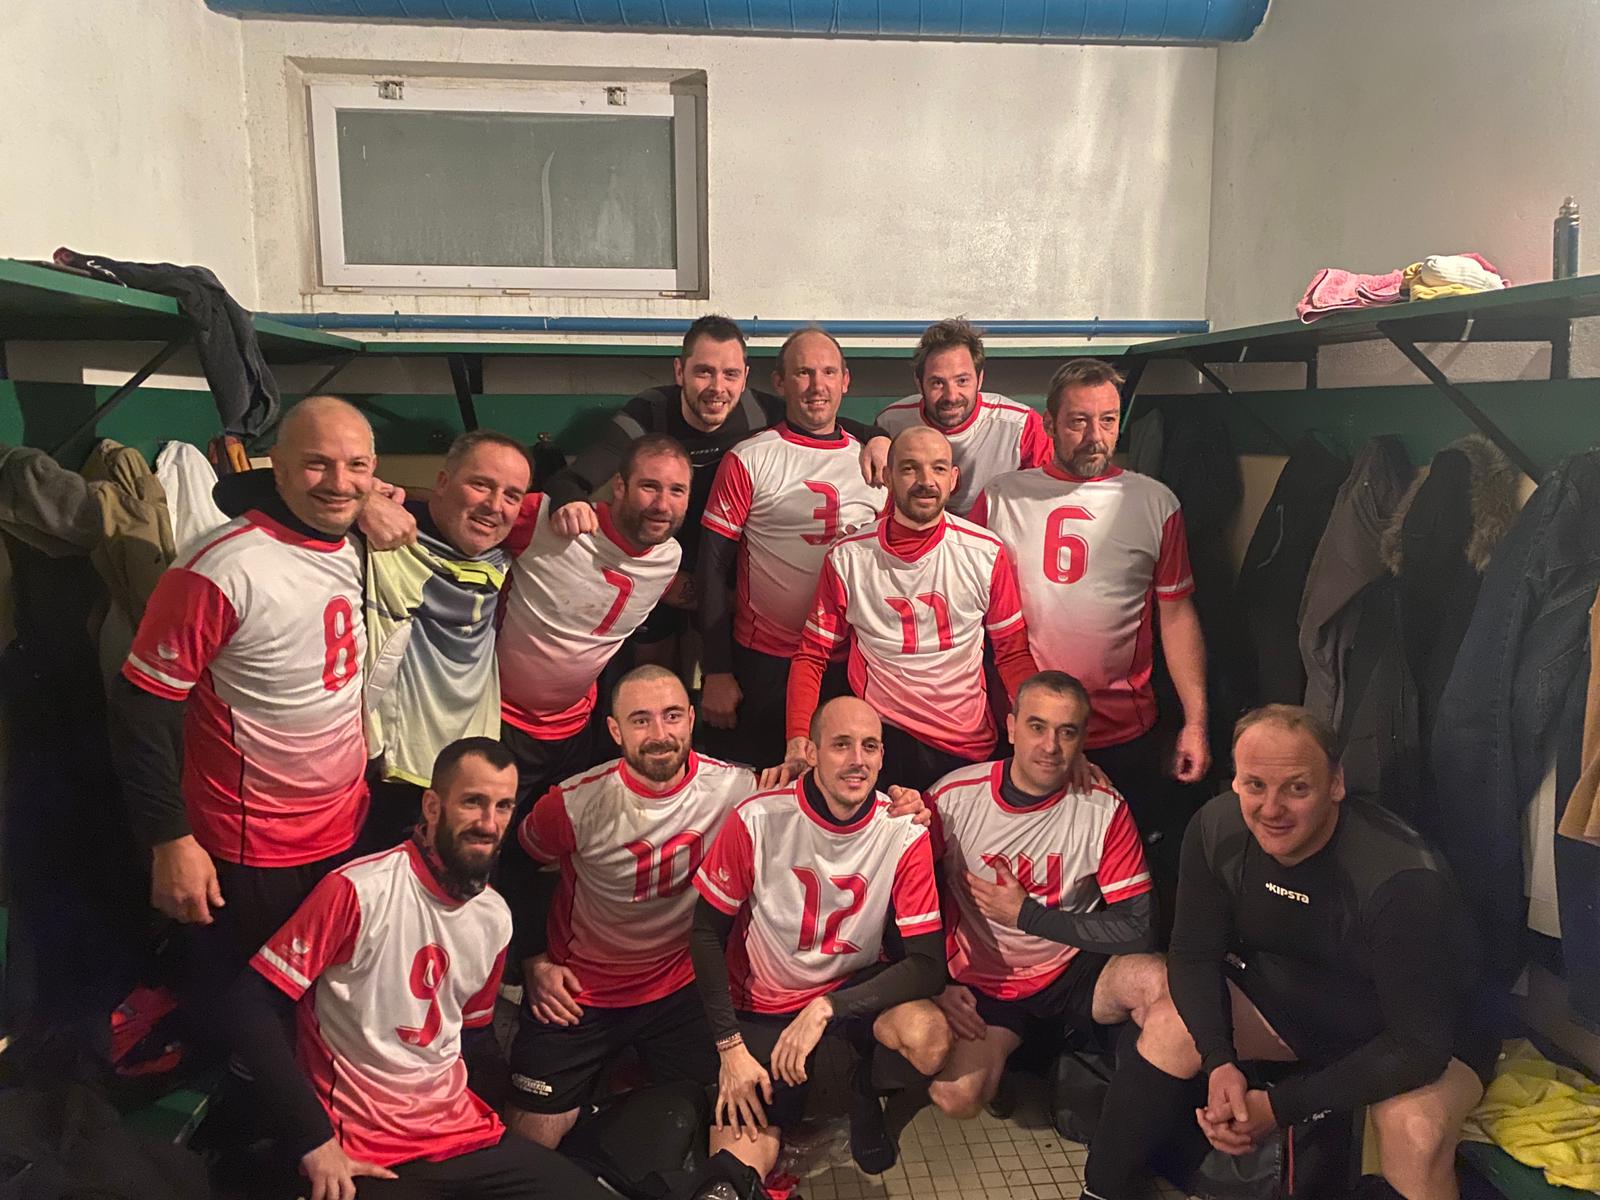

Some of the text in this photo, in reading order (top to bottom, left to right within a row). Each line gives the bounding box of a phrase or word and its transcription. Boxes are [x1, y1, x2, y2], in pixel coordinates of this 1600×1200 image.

[800, 479, 841, 546] 3
[1043, 505, 1096, 585] 6
[590, 567, 635, 636] 7
[322, 594, 359, 692] 8
[624, 830, 705, 903] 10
[790, 865, 868, 955] 12
[395, 943, 450, 1048] 9
